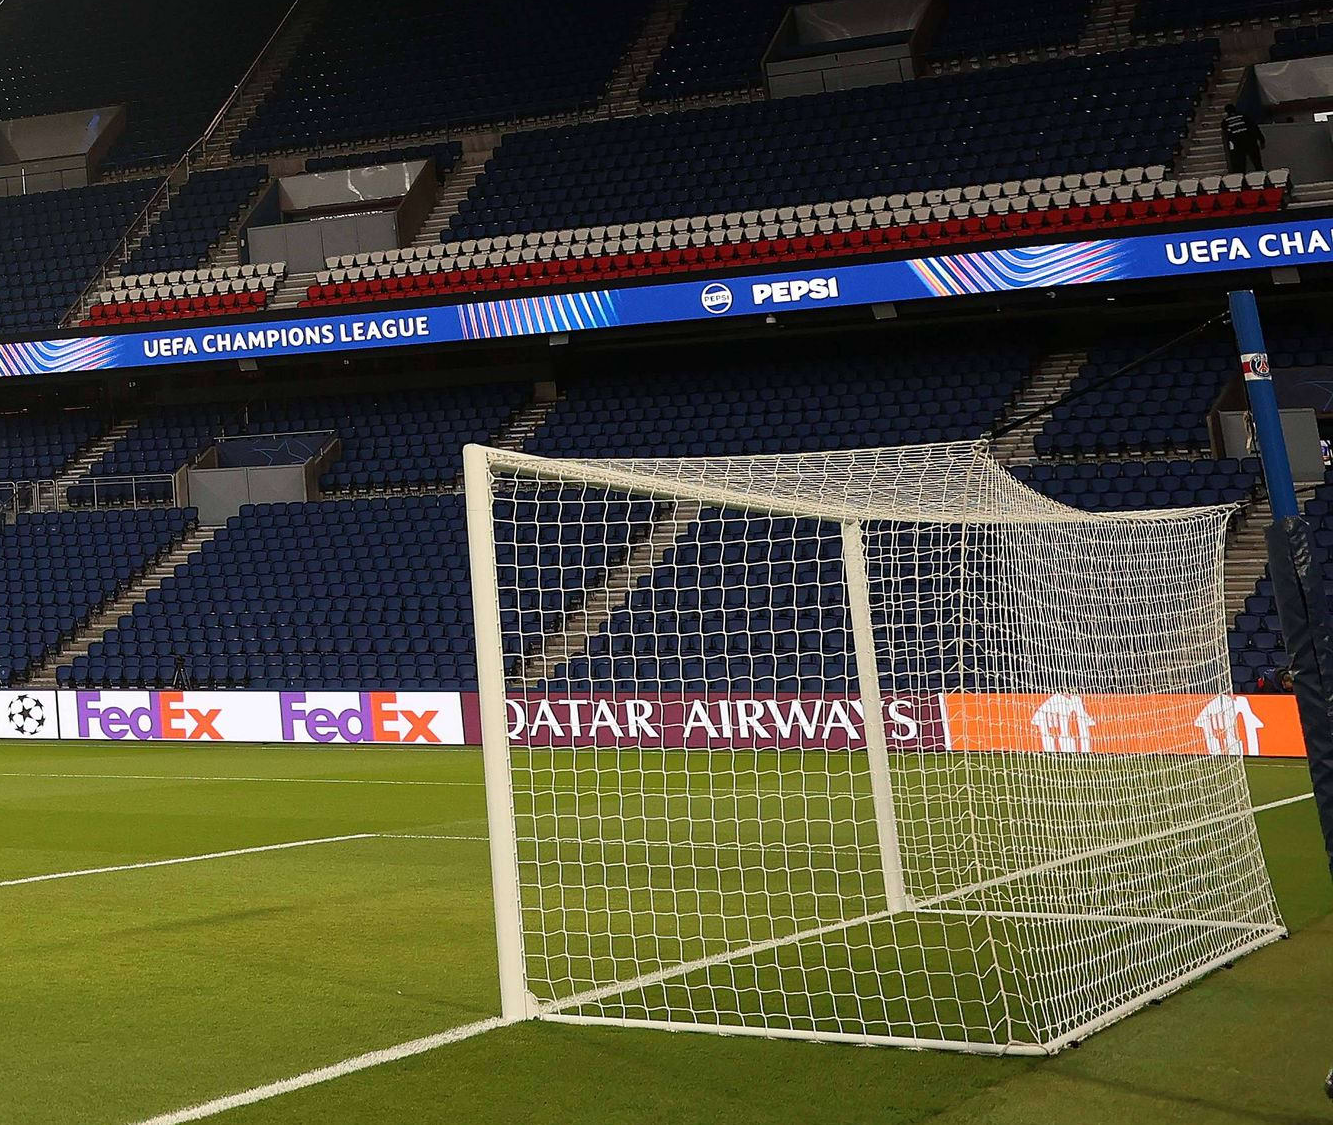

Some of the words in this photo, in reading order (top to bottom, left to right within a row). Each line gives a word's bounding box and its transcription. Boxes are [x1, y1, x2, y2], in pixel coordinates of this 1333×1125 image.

[1165, 238, 1251, 266] UEFA
[1258, 228, 1333, 257] CHA
[704, 294, 730, 303] PEPSI
[752, 276, 838, 305] PEPSI
[143, 337, 198, 359] UEFA
[202, 325, 335, 353] CHAMPIONS
[340, 316, 430, 343] LEAGUE
[76, 691, 225, 741] FedEx
[279, 691, 442, 743] FedEx
